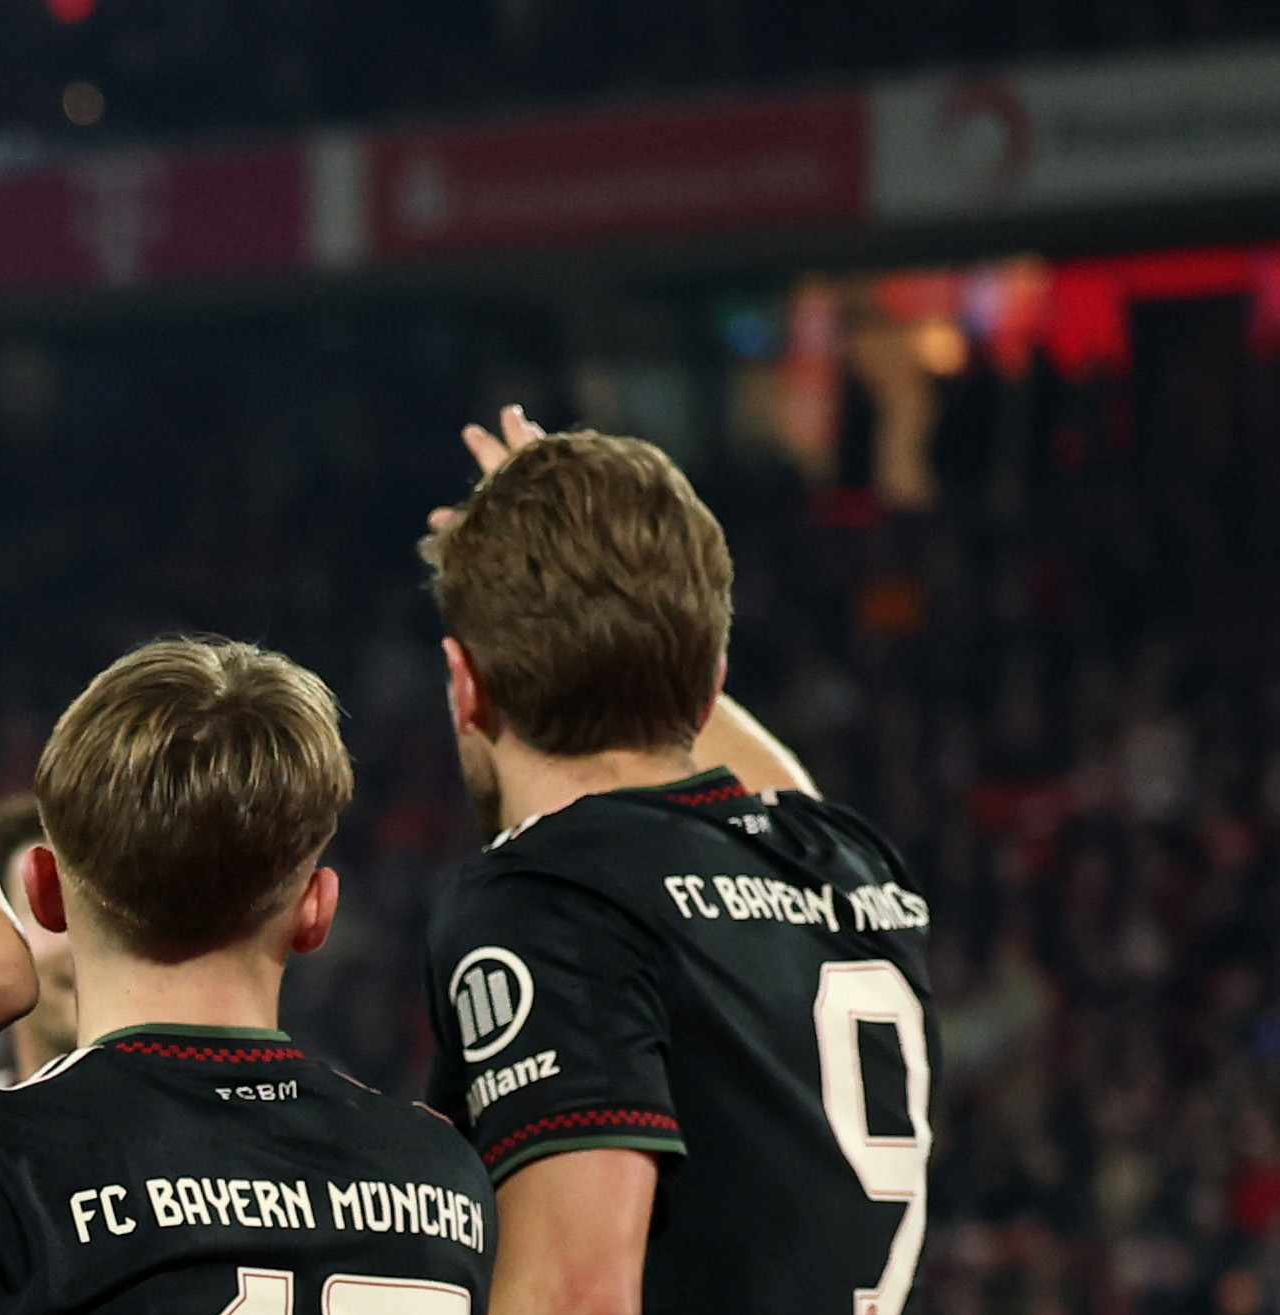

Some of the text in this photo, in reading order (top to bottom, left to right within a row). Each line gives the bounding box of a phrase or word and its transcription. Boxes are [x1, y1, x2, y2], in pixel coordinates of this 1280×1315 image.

[664, 875, 720, 919] FC
[214, 1079, 298, 1101] FCBM
[70, 1177, 484, 1254] FC BAYERN MÜNCHEN
